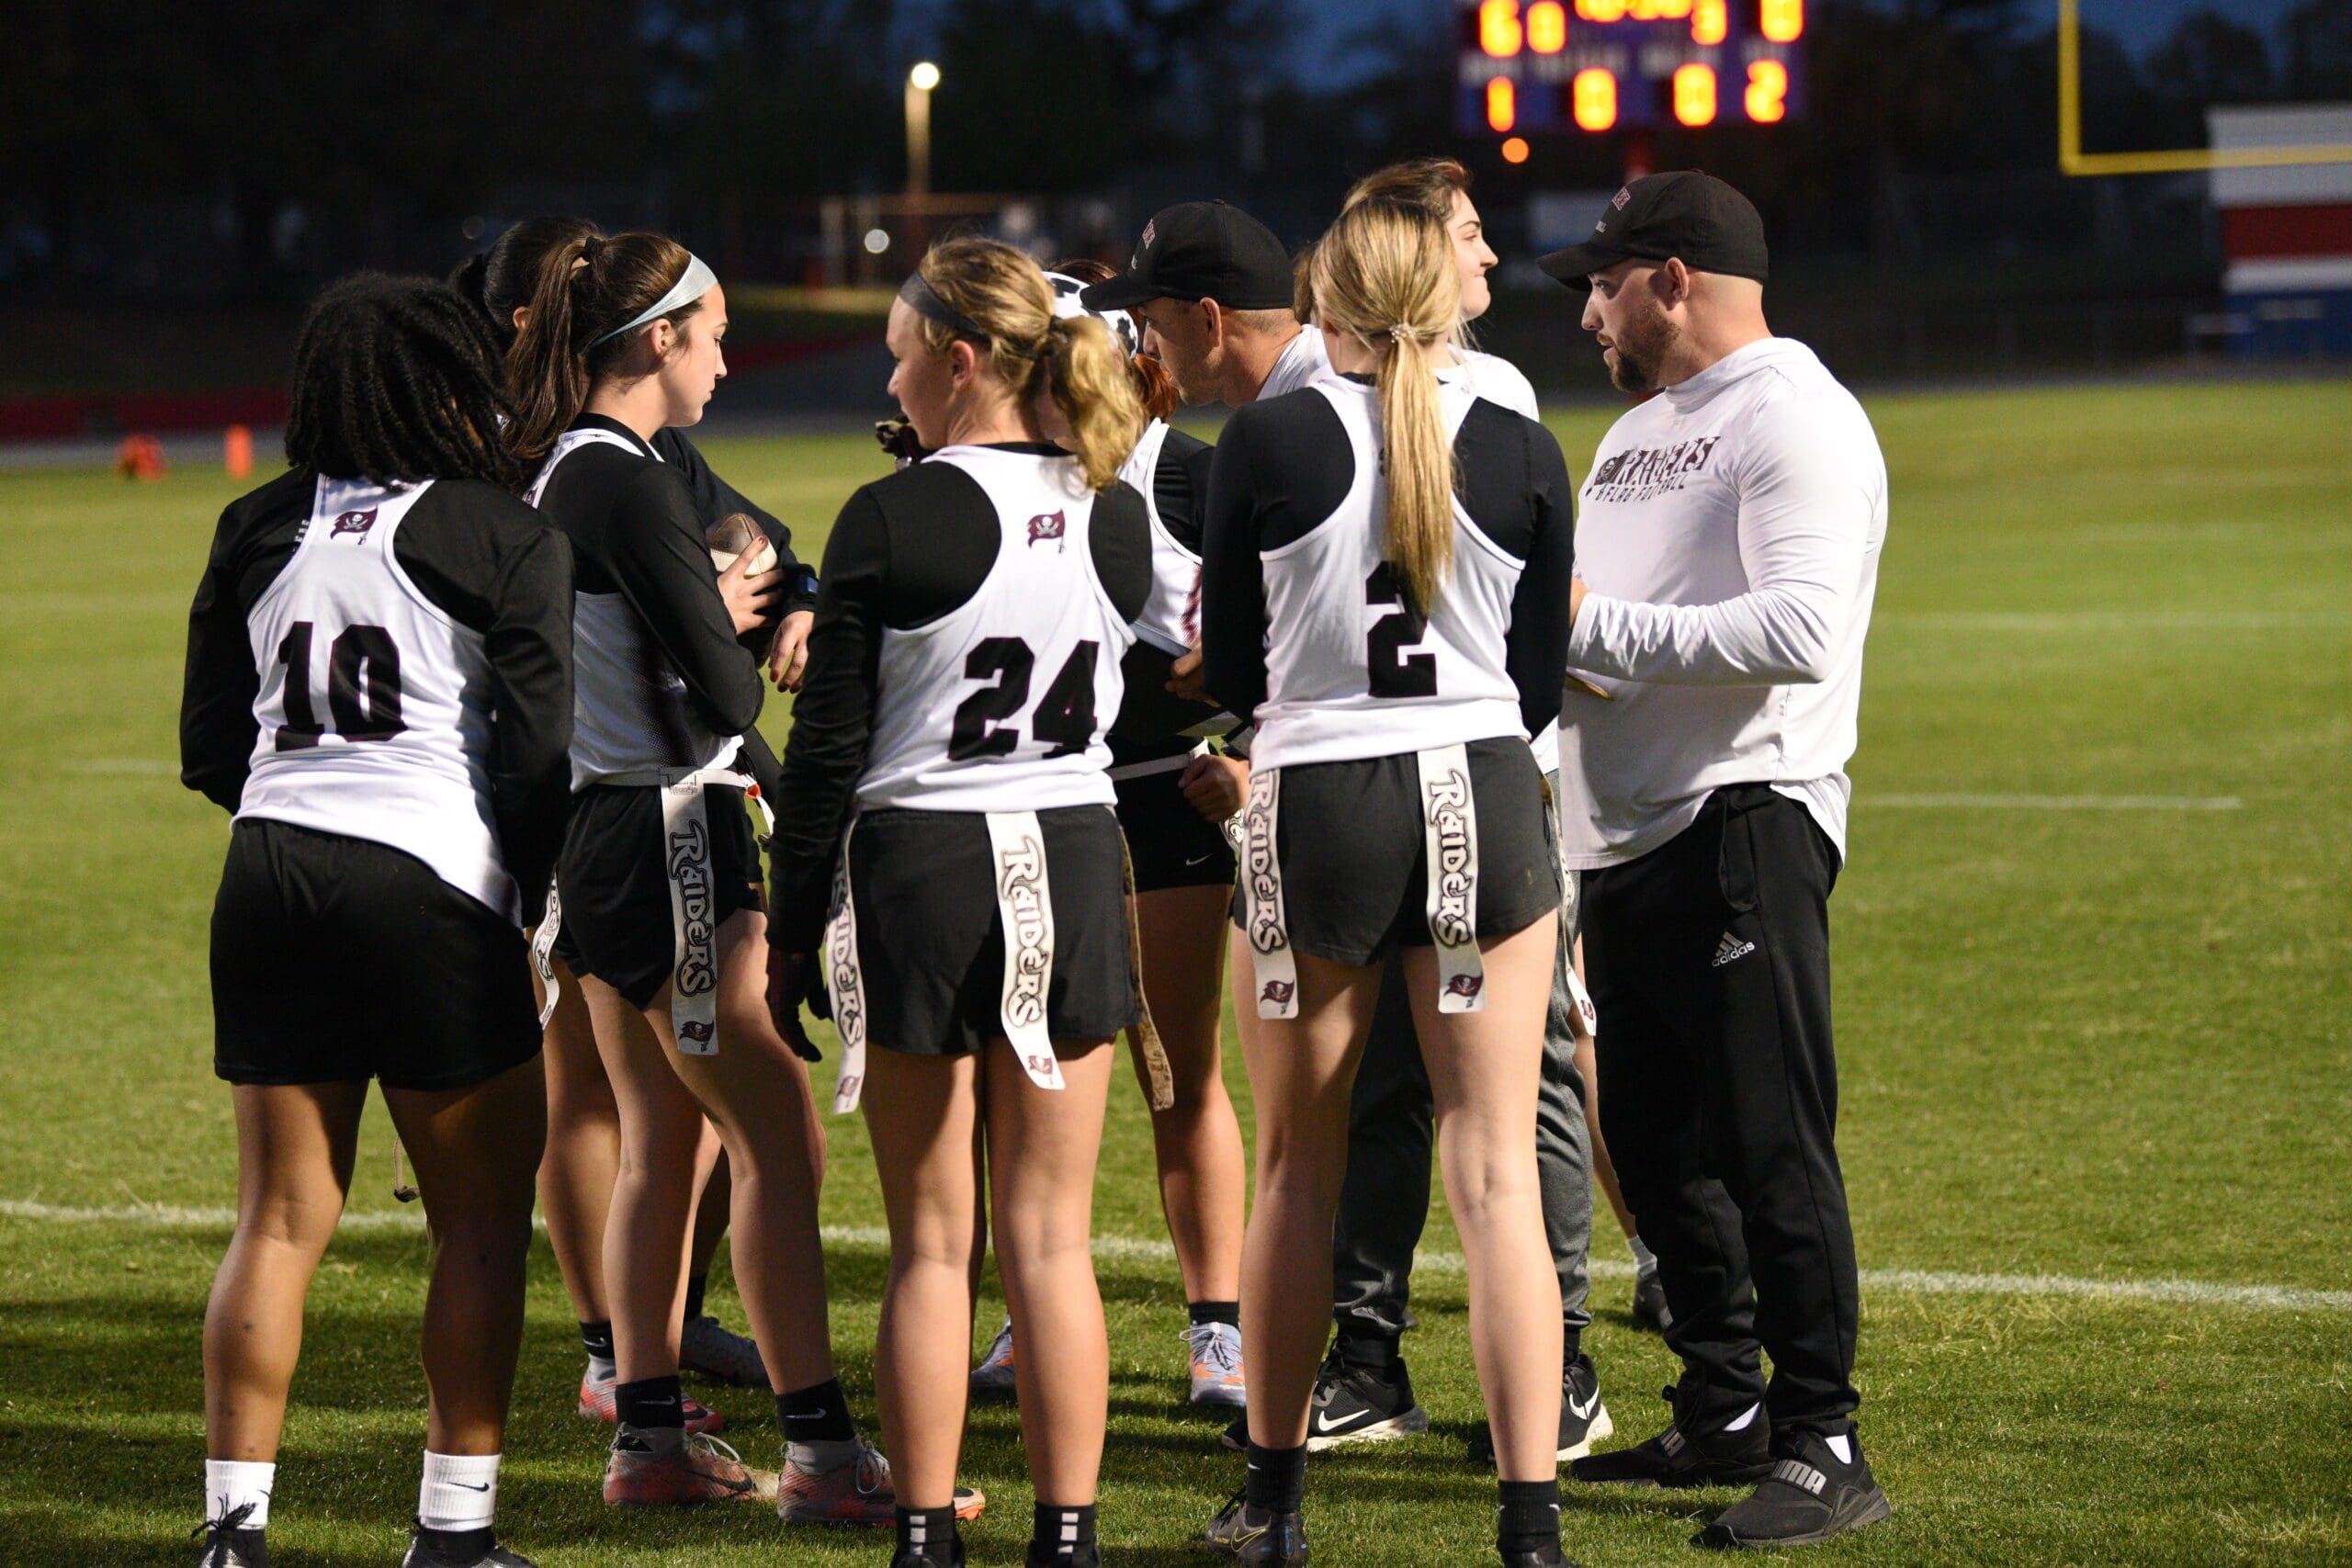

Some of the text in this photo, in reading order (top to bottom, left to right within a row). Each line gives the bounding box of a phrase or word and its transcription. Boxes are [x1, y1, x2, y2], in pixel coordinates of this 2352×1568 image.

[1746, 60, 1787, 122] 2
[276, 621, 408, 751] 10
[1366, 560, 1437, 698] 2
[947, 637, 1100, 761] 24
[668, 818, 717, 998] RAIDERS
[1427, 769, 1474, 948] RAIDERS
[1001, 834, 1050, 1028] RAIDERS
[1712, 942, 1756, 967] adidas
